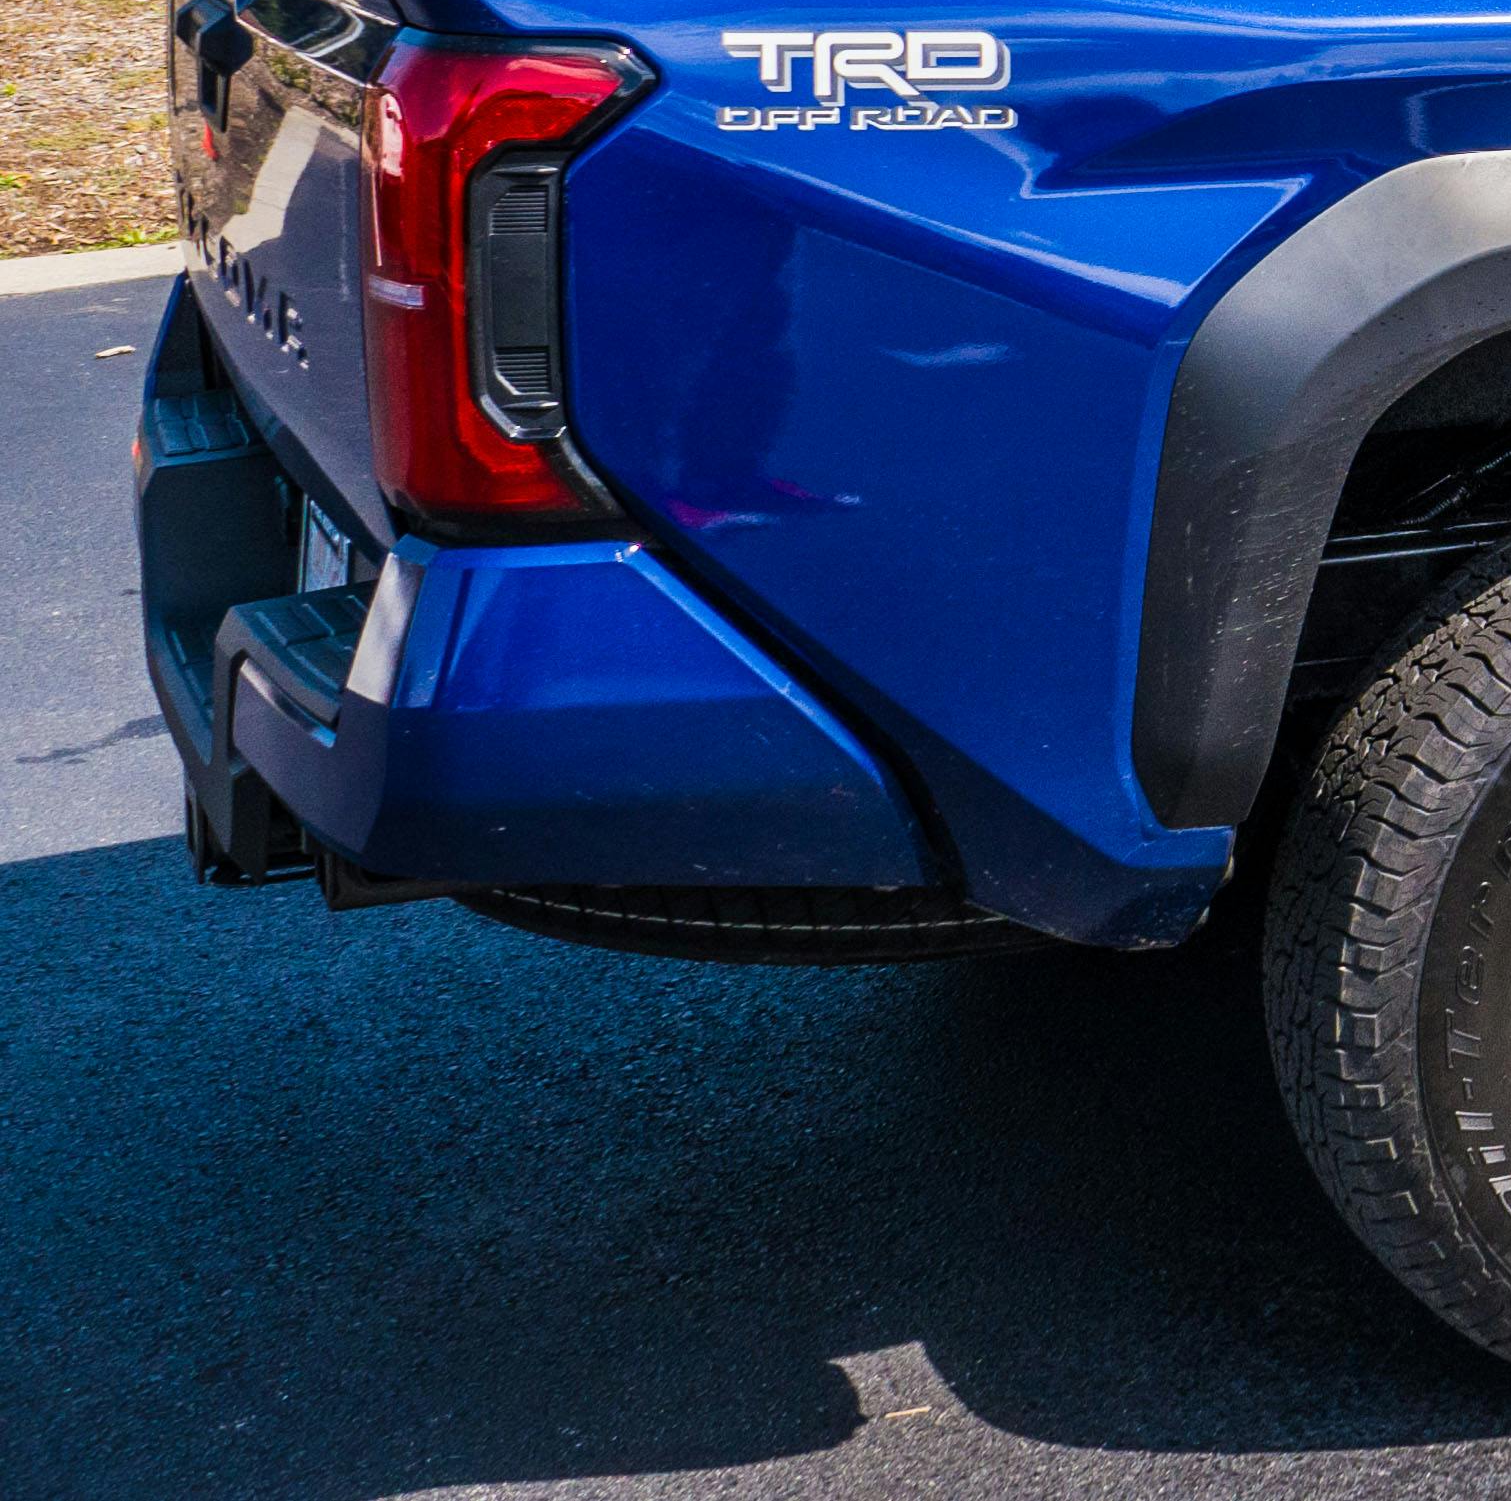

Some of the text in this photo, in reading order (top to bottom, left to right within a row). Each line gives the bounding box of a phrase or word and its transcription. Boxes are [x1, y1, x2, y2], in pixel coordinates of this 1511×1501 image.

[721, 31, 1011, 107] TRD
[716, 104, 1018, 131] OFF ROAD
